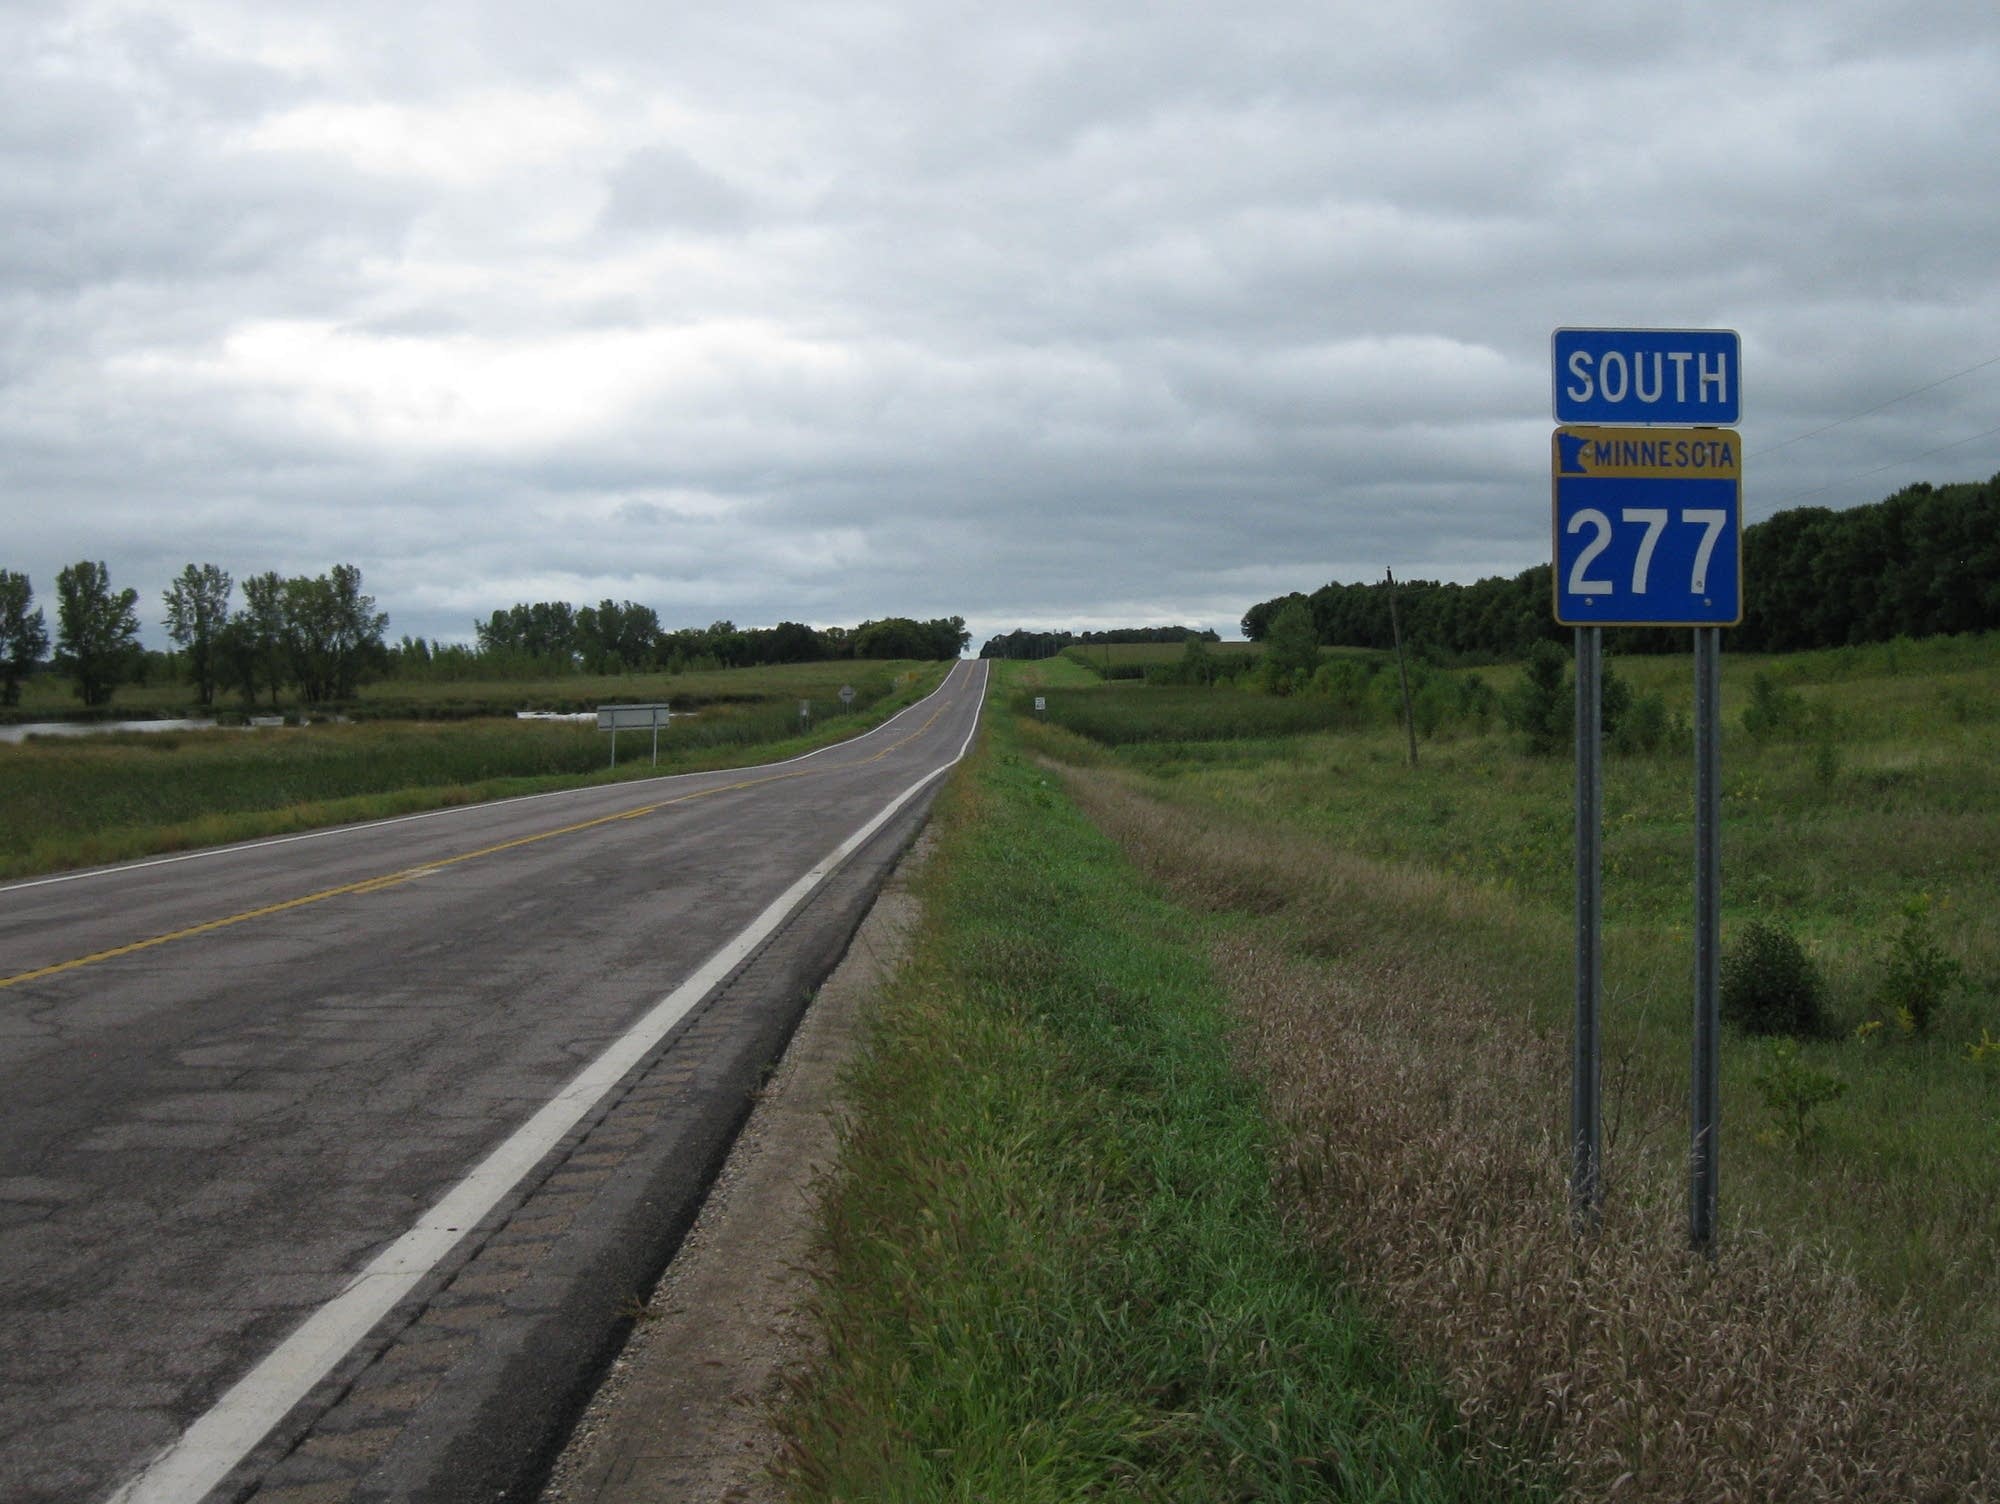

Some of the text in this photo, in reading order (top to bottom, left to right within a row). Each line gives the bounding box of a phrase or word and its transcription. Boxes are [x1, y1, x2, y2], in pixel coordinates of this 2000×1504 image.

[1567, 350, 1727, 403] SOUTH
[1594, 440, 1734, 468] MINNESOTA
[1567, 508, 1727, 595] 277
